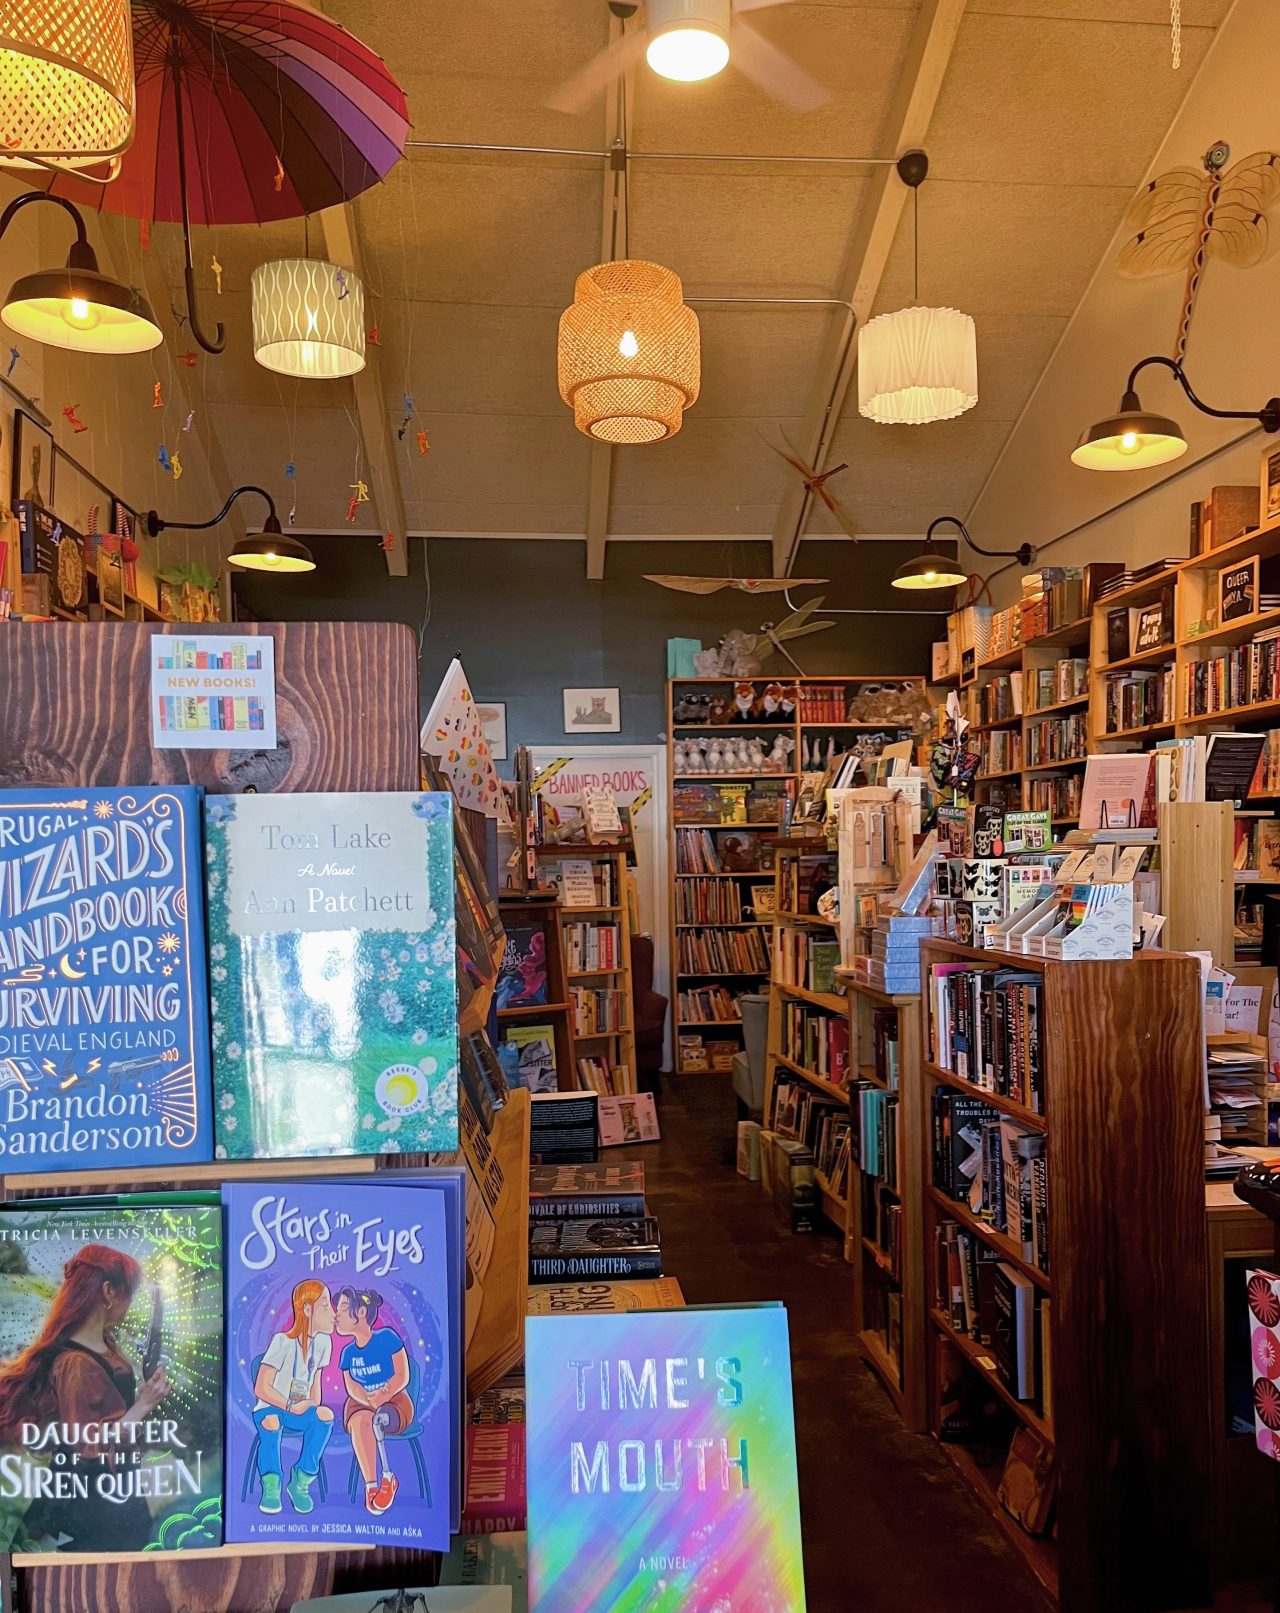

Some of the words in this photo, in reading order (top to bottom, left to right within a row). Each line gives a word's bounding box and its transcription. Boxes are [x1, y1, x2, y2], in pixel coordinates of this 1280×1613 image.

[1226, 571, 1250, 589] QUEER
[168, 678, 199, 688] NEW
[203, 678, 257, 688] BOOKS!
[603, 770, 648, 792] BOOKS
[1006, 814, 1030, 822] GREAT
[1030, 812, 1047, 820] GAYS
[261, 825, 320, 850] Tom
[331, 823, 392, 849] Lake
[297, 863, 315, 877] A
[317, 862, 357, 877] Novel
[307, 886, 414, 914] Patchett
[92, 936, 156, 976] FOR
[1242, 998, 1260, 1006] The
[79, 1028, 176, 1051] ENGLAND
[6, 1083, 152, 1123] Brandon
[382, 1100, 401, 1113] BOOK
[404, 1098, 422, 1113] CLUB
[558, 1204, 567, 1216] OF
[568, 1203, 620, 1215] CURIOSITIES
[0, 1229, 60, 1241] TRICIA
[240, 1196, 332, 1270] Stars
[335, 1211, 353, 1229] in
[302, 1244, 350, 1272] Their
[353, 1218, 425, 1277] Eyes
[532, 1258, 566, 1276] THIRD
[567, 1257, 632, 1276] DAUGHTER
[352, 1356, 366, 1367] THE
[352, 1363, 382, 1376] FUTURE
[567, 1356, 744, 1412] TIME'S
[22, 1420, 188, 1450] DAUGHTER
[472, 1428, 510, 1461] HENRY
[54, 1452, 82, 1466] OF
[100, 1452, 141, 1465] THE
[570, 1438, 750, 1494] MOUTH
[0, 1454, 89, 1499] SIREN
[96, 1450, 203, 1504] QUEEN
[467, 1466, 508, 1504] EMILY
[250, 1524, 256, 1532] A
[258, 1524, 286, 1532] GRAPHIC
[288, 1524, 309, 1533] NOVEL
[311, 1524, 320, 1532] BY
[322, 1523, 352, 1534] JESSICA
[354, 1524, 386, 1536] WALTON
[387, 1527, 401, 1536] AND
[638, 1556, 646, 1570] A
[650, 1556, 689, 1570] NOVEL
